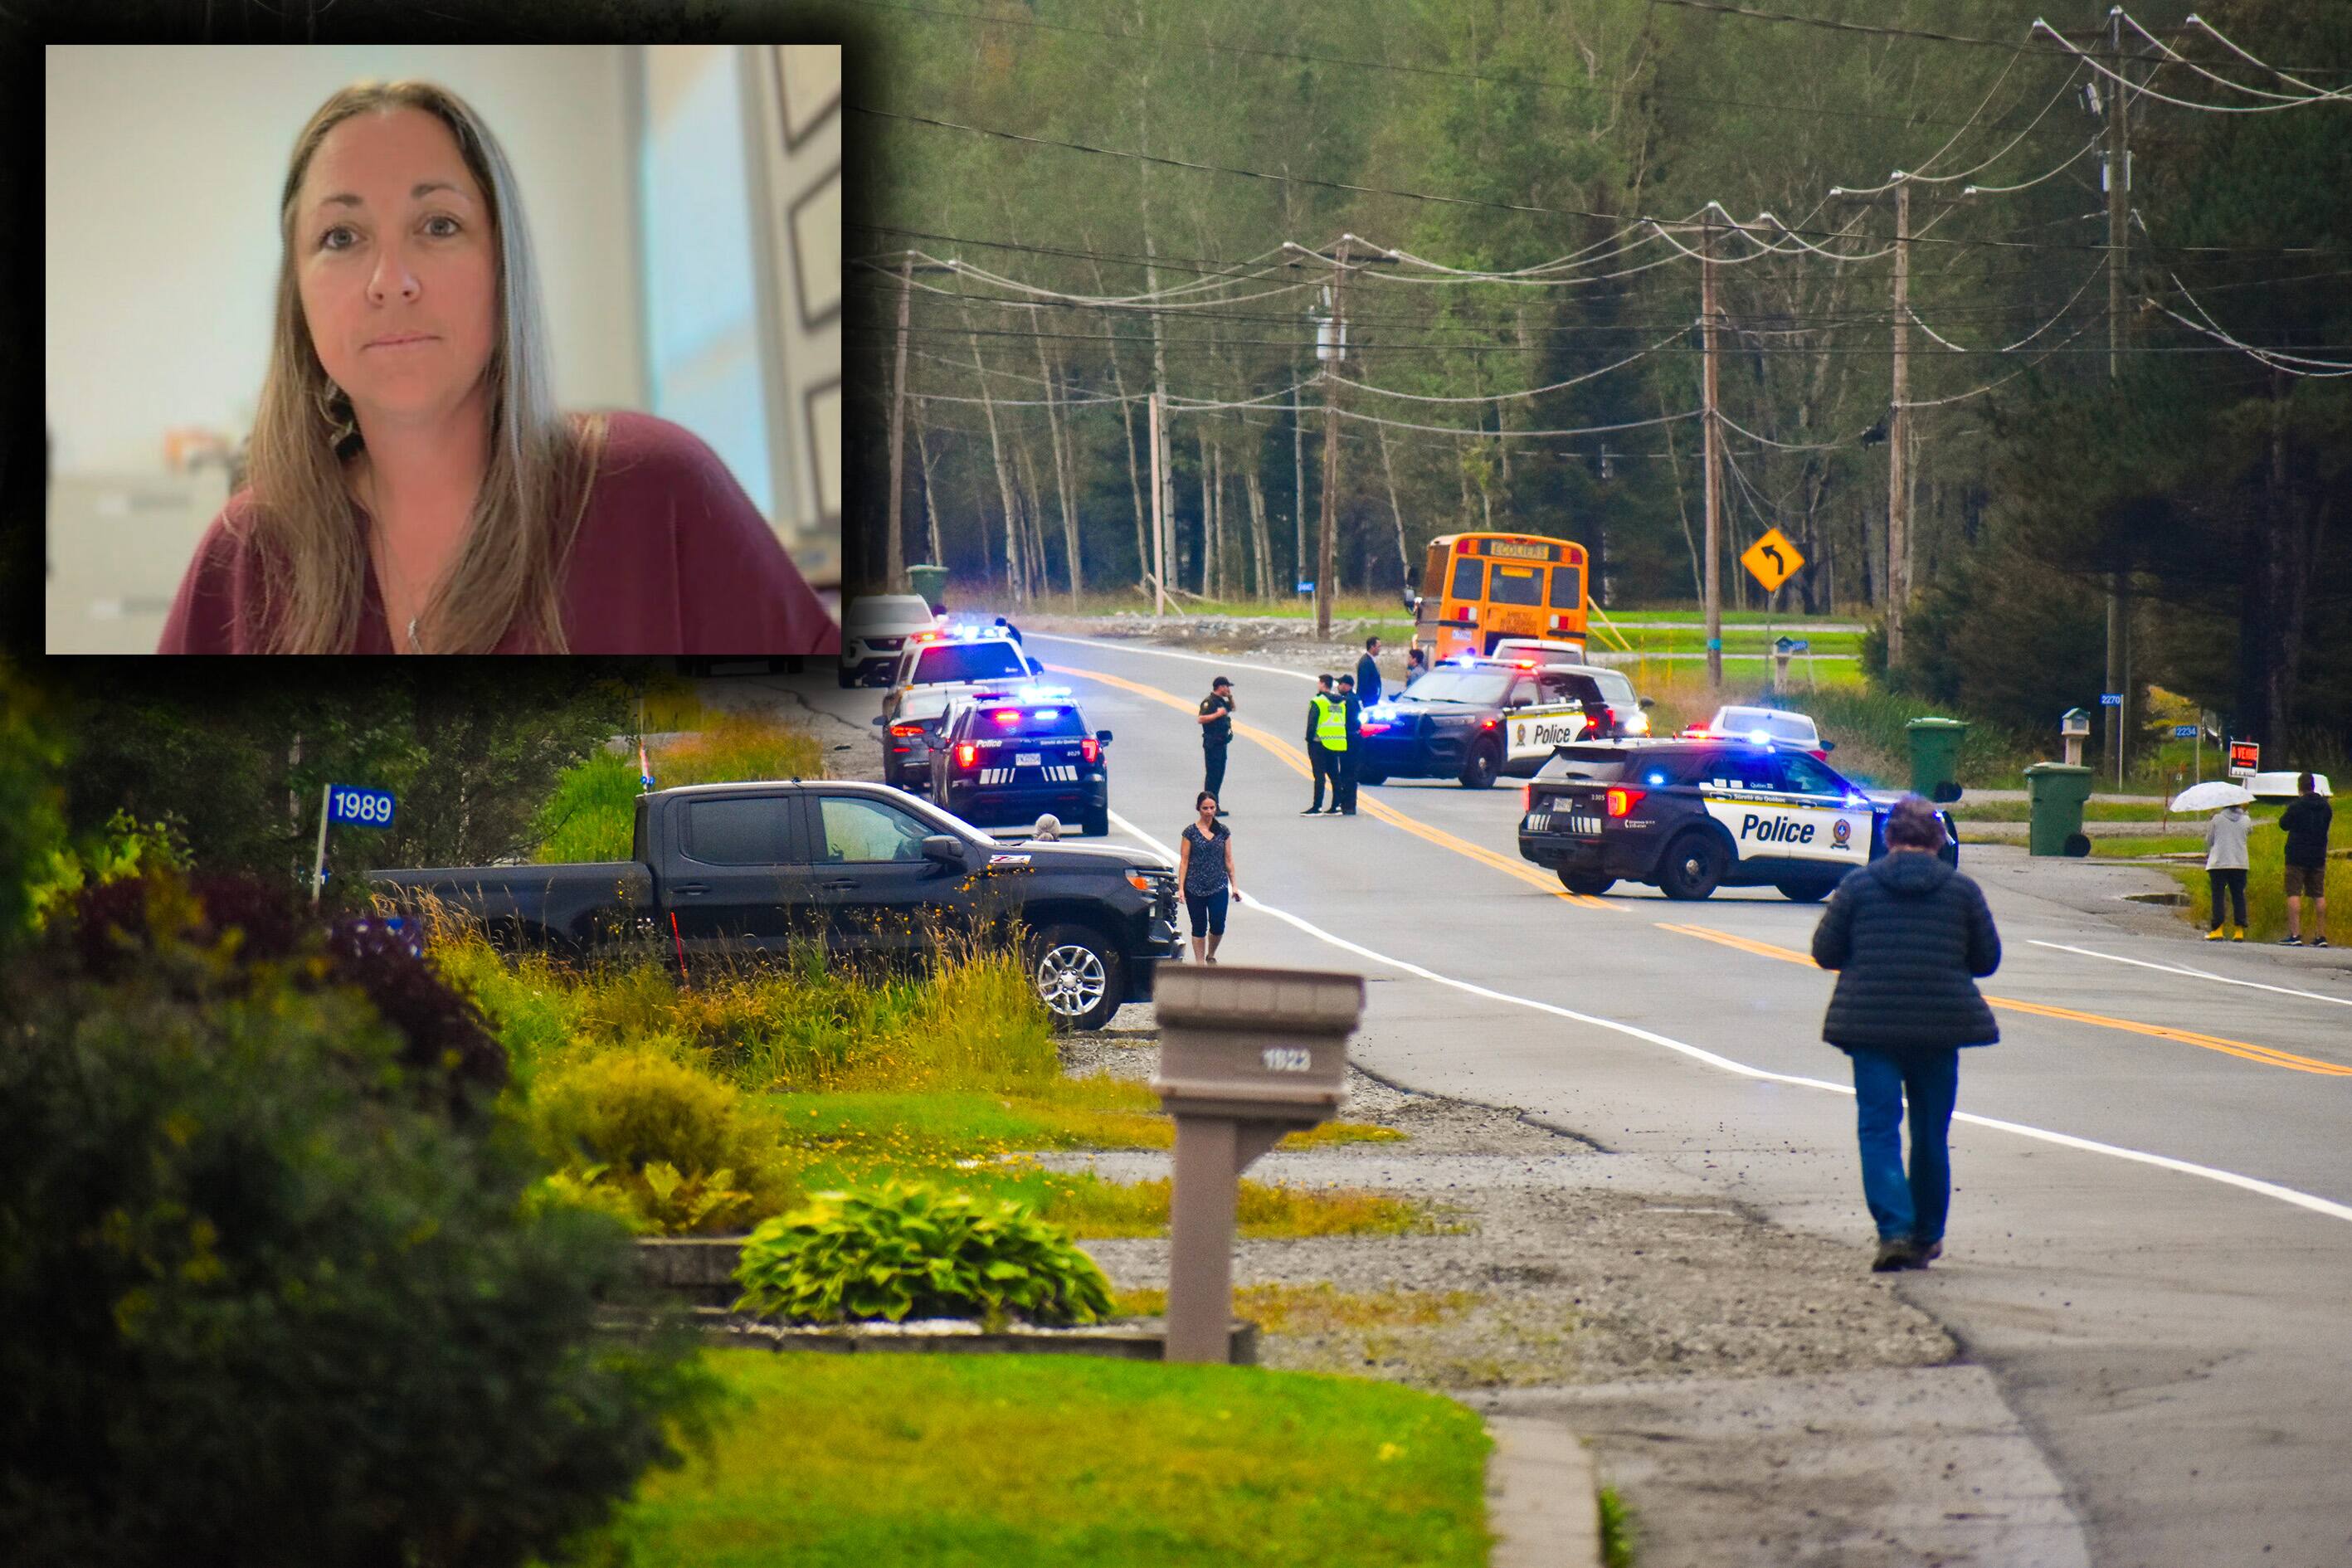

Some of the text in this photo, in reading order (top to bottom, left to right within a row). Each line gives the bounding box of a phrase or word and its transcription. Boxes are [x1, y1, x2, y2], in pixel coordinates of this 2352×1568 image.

[2101, 695, 2121, 704] 2270
[1534, 723, 1570, 745] Police
[2176, 727, 2197, 737] 2234
[976, 739, 1003, 748] Police
[334, 791, 392, 822] 1989
[1741, 814, 1814, 844] Police
